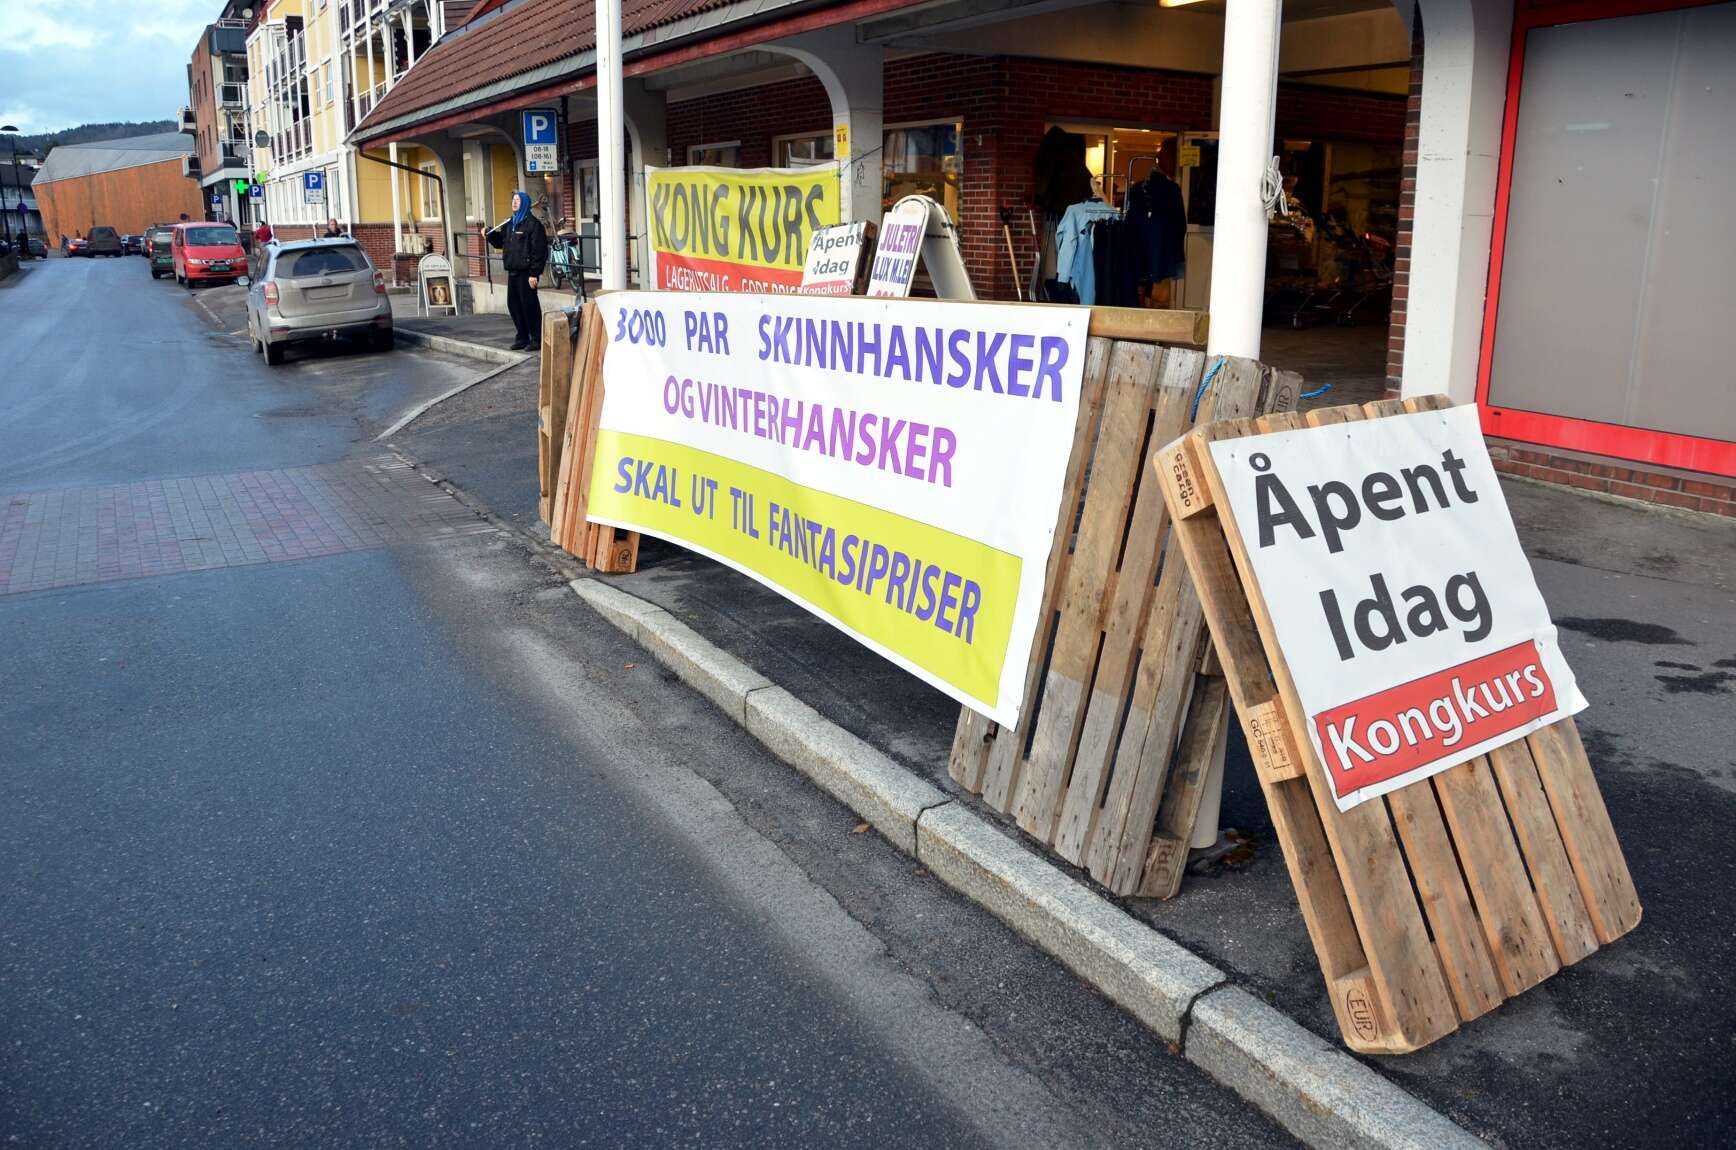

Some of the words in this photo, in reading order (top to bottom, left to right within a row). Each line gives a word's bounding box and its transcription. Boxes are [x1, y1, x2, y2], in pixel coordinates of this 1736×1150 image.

[531, 115, 549, 141] P
[251, 186, 260, 197] P
[309, 174, 319, 188] P
[653, 182, 730, 257] KONG
[613, 306, 667, 348] 3000
[684, 310, 731, 356] PAR
[757, 313, 1071, 403] SKINNHANSKER
[1248, 448, 1479, 555] Åpent
[613, 456, 682, 508] SKAL
[691, 473, 719, 520] UT
[729, 486, 760, 539] TIL
[768, 503, 983, 645] FANTASIPRISER
[1318, 570, 1494, 662] Idag
[1325, 662, 1546, 772] Kongkurs
[1349, 999, 1373, 1031] EUR
